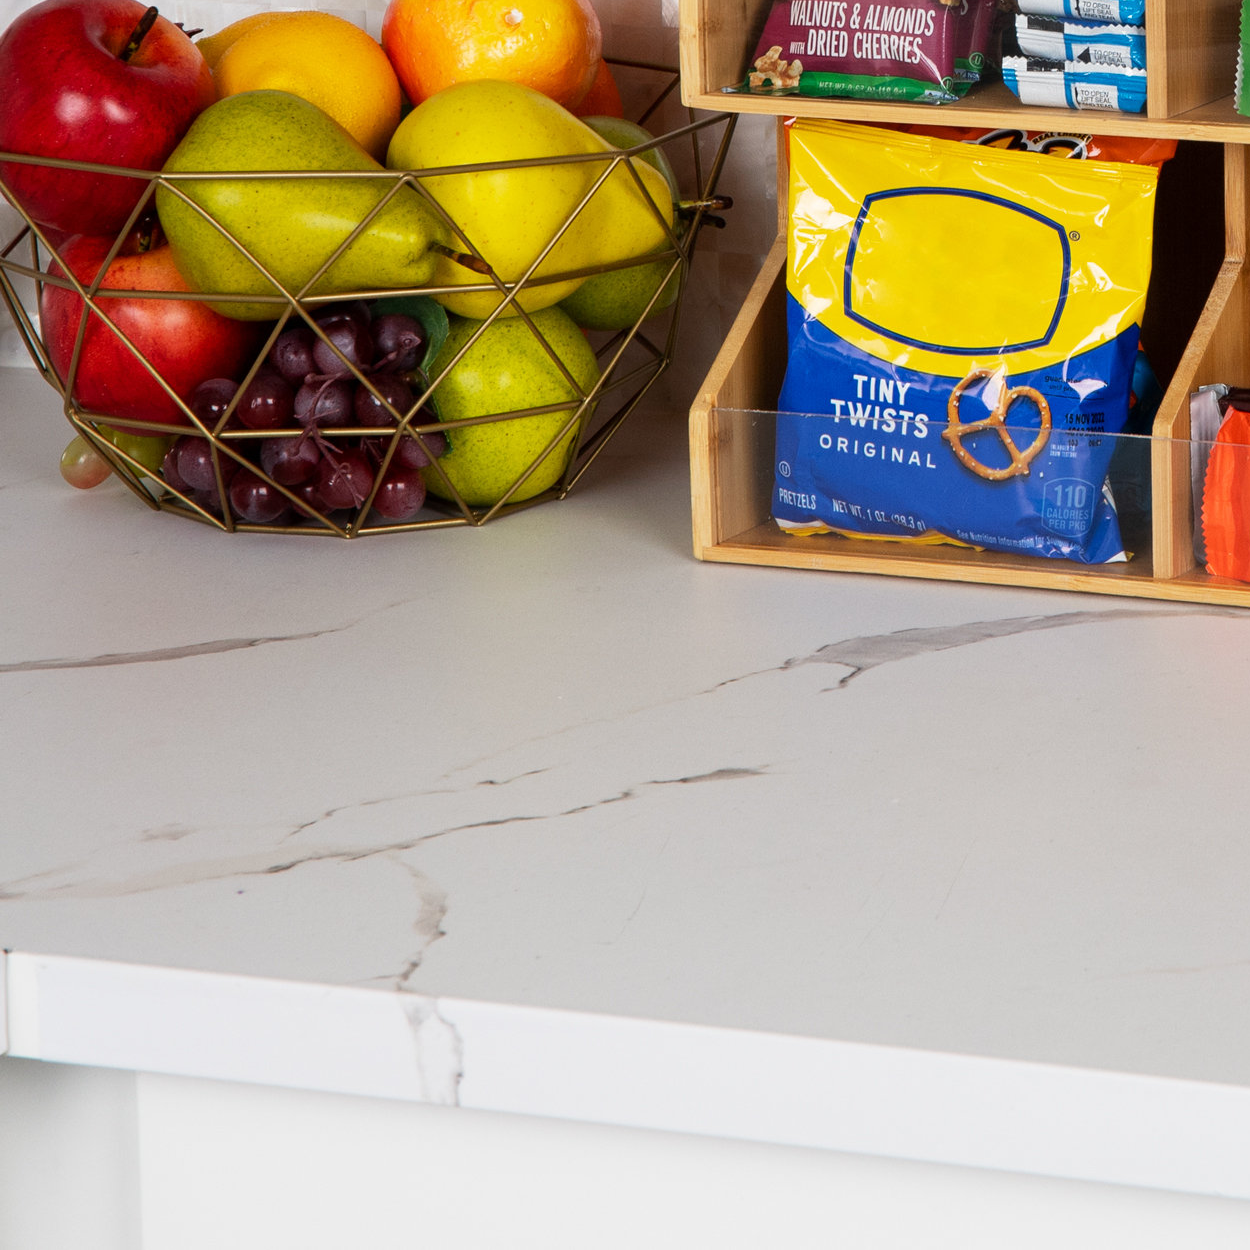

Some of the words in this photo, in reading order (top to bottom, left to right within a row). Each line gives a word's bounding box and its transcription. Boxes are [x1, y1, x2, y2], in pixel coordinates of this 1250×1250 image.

[1094, 2, 1110, 10] OPEN
[790, 0, 847, 29] WALNUTS
[850, 3, 861, 30] &
[863, 5, 936, 36] ALMONDS
[789, 41, 805, 55] WITH
[807, 29, 848, 58] DRIED
[853, 32, 922, 64] CHERRIES
[1104, 50, 1121, 58] OPEN
[1031, 132, 1055, 145] REAL
[853, 374, 911, 406] TINY
[831, 399, 929, 438] TWISTS
[1065, 413, 1073, 424] 15
[1075, 414, 1089, 424] NOV
[819, 433, 936, 468] ORIGINAL
[779, 487, 817, 510] PRETZELS
[1054, 484, 1086, 508] 110
[832, 499, 848, 513] NET
[848, 503, 865, 519] WT.
[867, 509, 872, 521] 1
[891, 513, 915, 529] (28.3
[1047, 508, 1089, 520] CALORIES
[1050, 520, 1066, 530] PER
[1068, 520, 1086, 531] PKG
[956, 530, 969, 540] See
[970, 531, 997, 544] Nutrition
[998, 536, 1035, 548] Information
